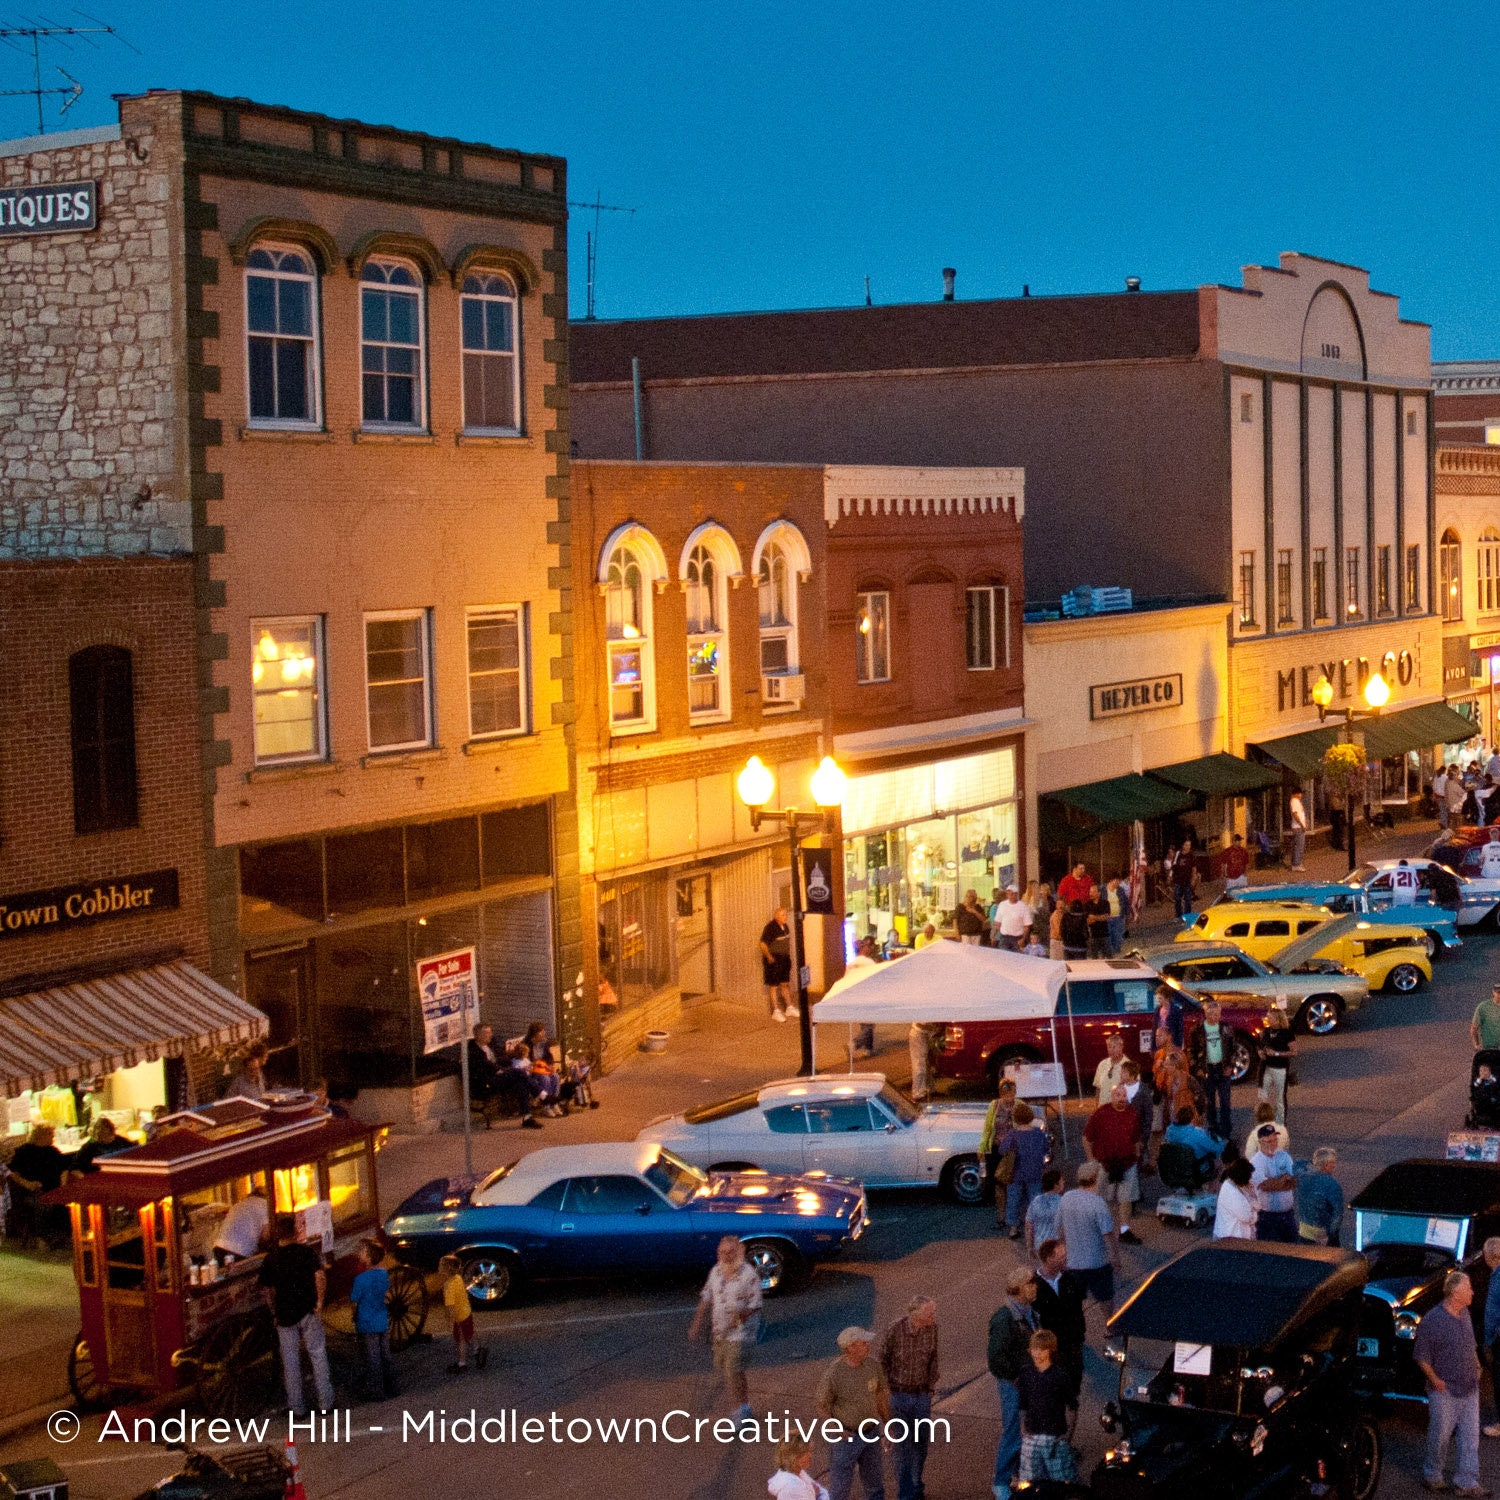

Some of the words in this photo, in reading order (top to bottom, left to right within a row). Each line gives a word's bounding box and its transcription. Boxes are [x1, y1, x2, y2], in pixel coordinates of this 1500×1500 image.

[1445, 666, 1466, 681] AVON
[1101, 685, 1150, 712] MEYER
[1154, 681, 1173, 702] CO
[1397, 871, 1412, 887] 21
[65, 884, 154, 918] Cobbler
